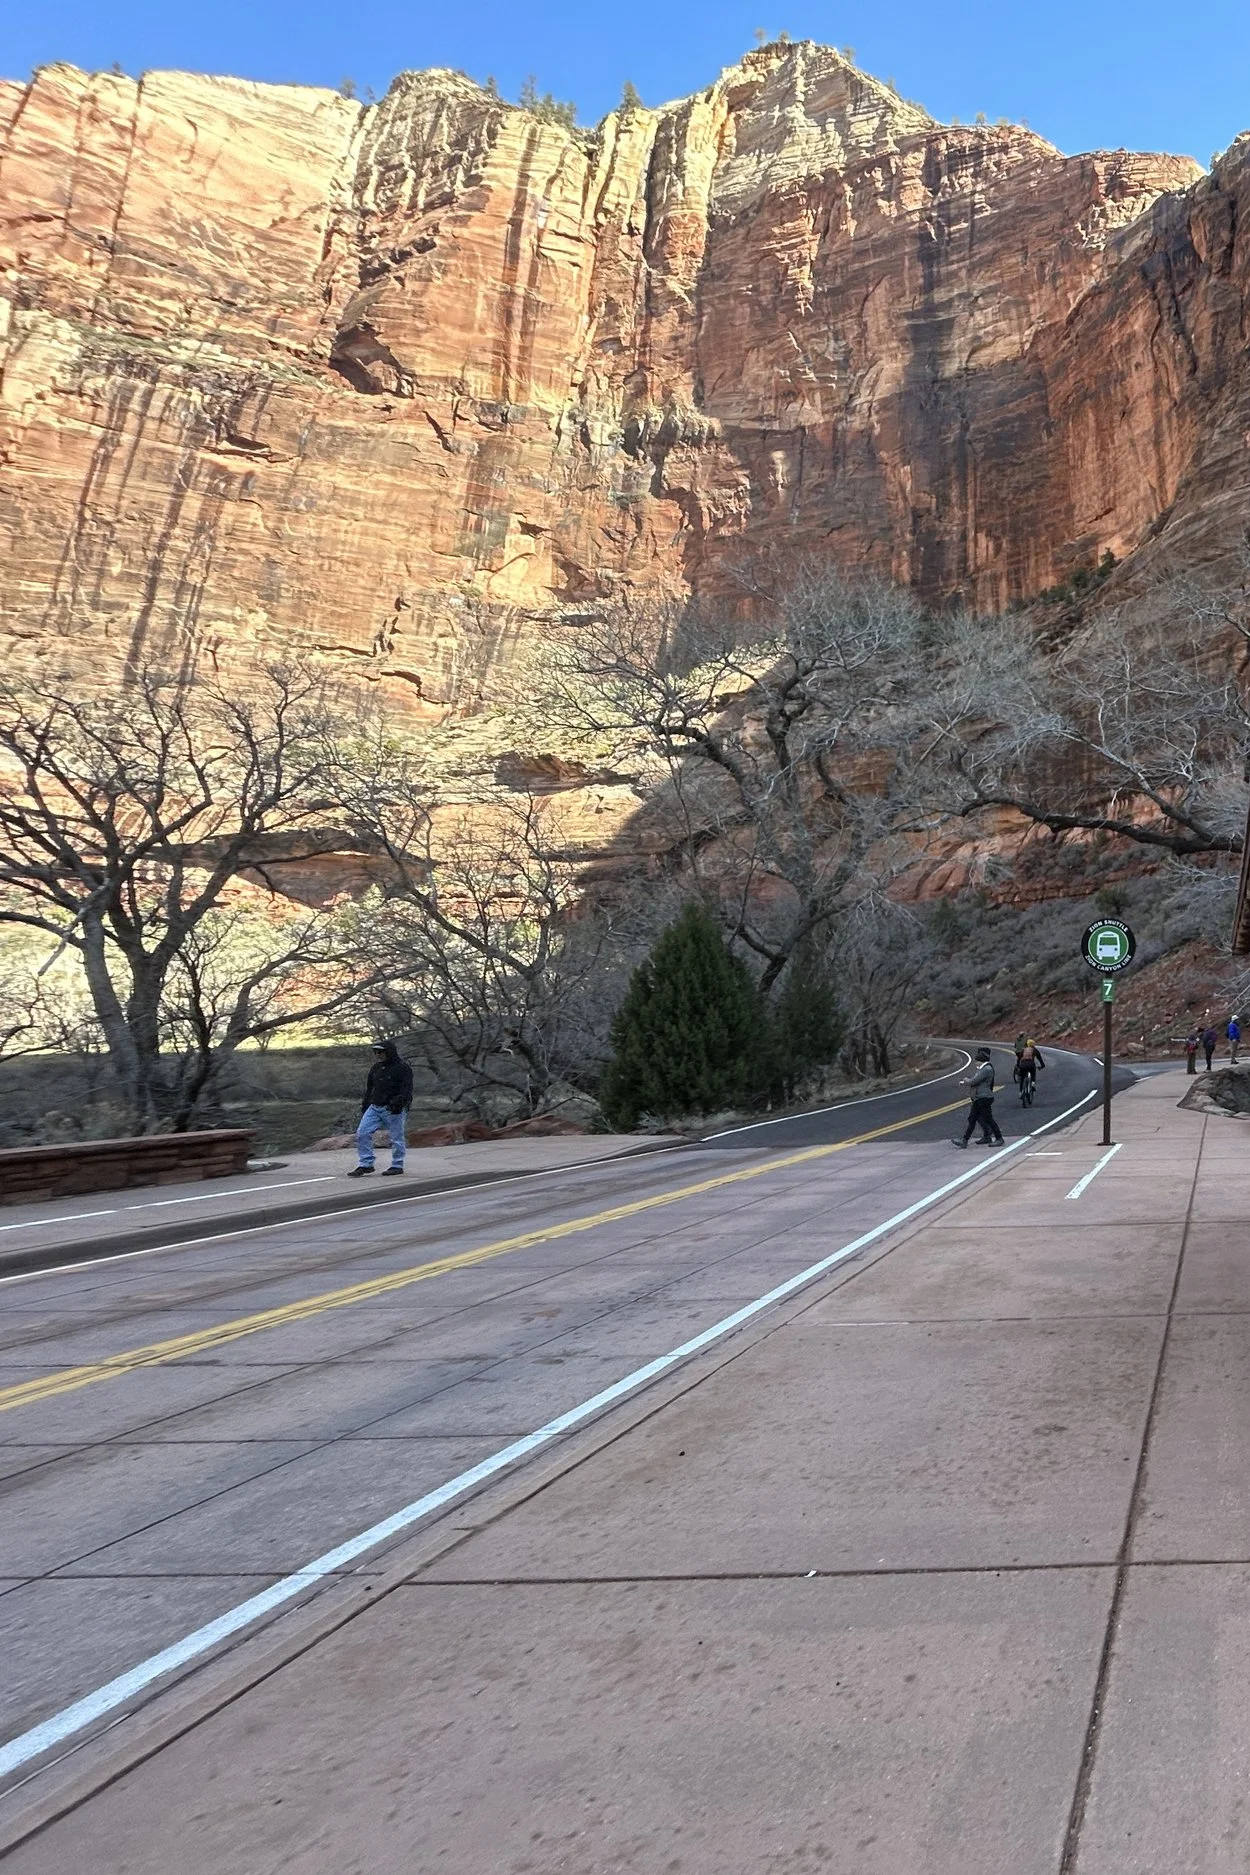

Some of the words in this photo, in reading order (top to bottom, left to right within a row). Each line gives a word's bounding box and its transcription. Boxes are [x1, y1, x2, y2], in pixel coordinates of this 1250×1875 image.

[1089, 920, 1103, 932] ZION
[1104, 919, 1128, 932] SHUTTLE
[1084, 955, 1096, 967] ZION
[1122, 955, 1132, 966] LINE
[1104, 983, 1112, 996] 7
